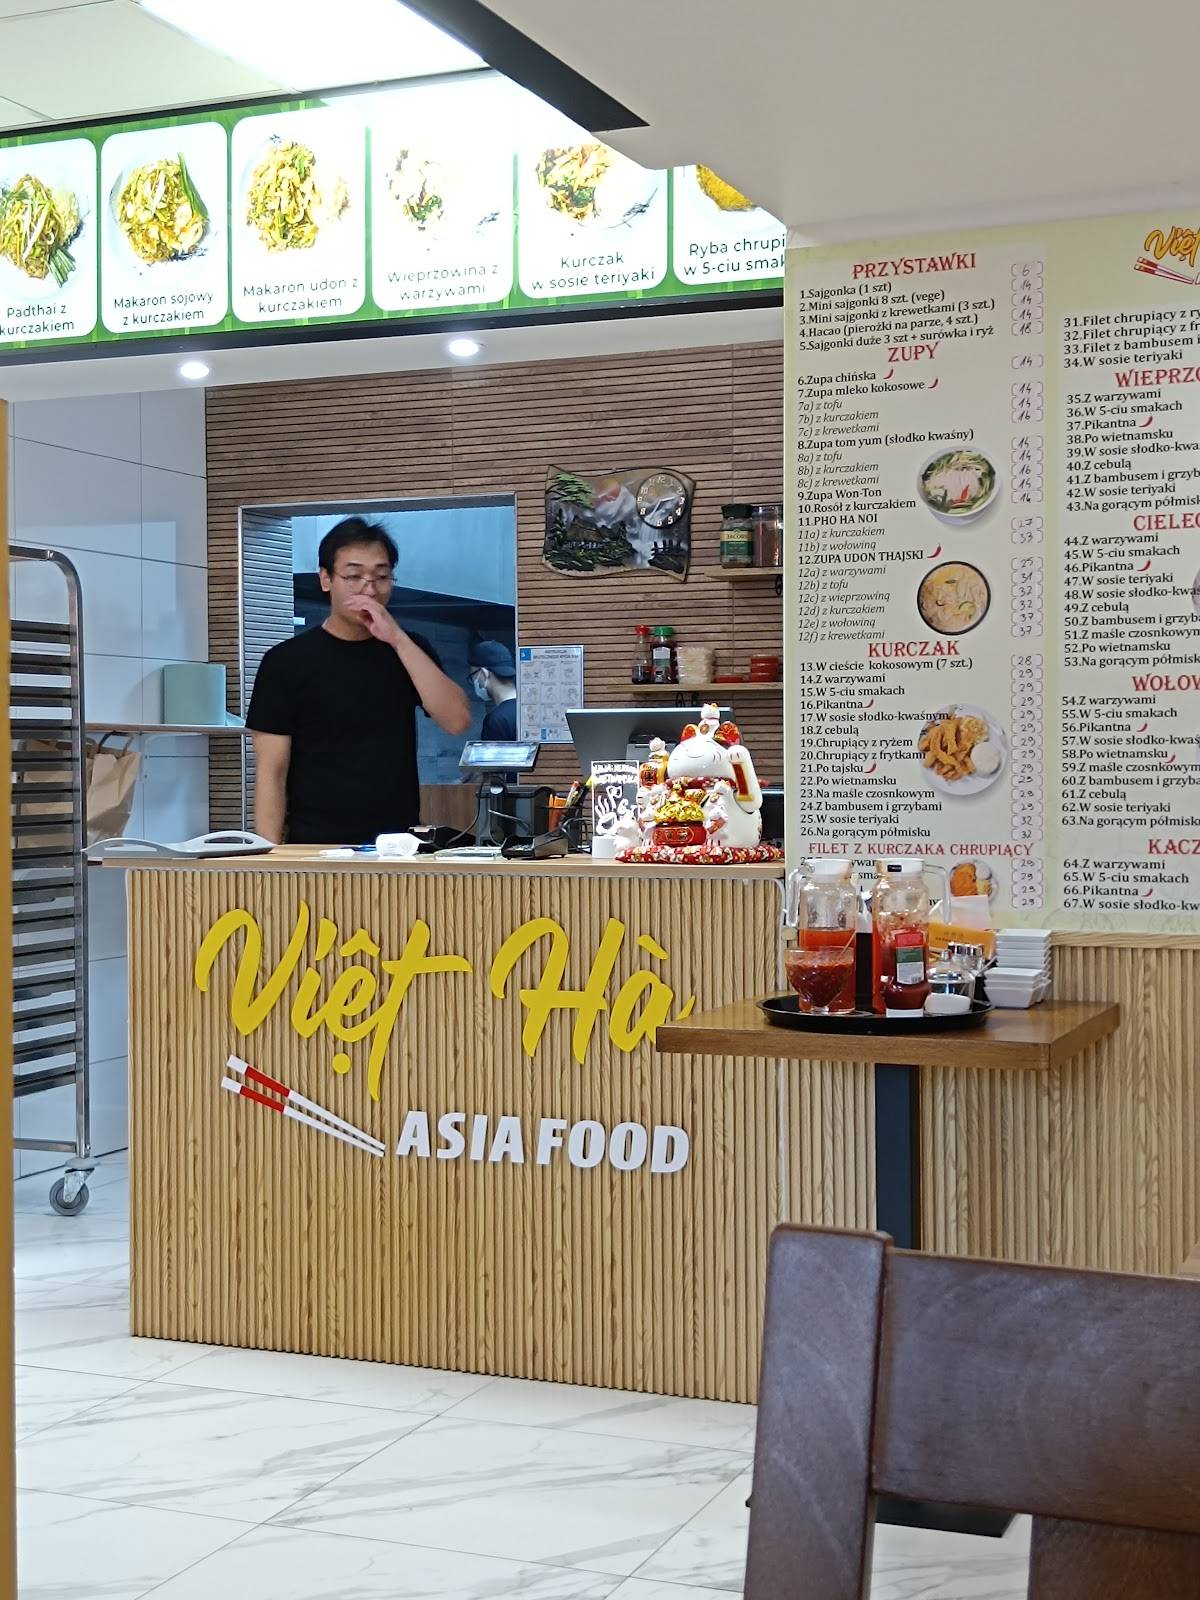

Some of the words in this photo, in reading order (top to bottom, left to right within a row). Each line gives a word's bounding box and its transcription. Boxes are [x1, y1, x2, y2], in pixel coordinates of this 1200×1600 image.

[689, 238, 728, 258] Ryba
[734, 233, 785, 252] chrupi
[561, 251, 624, 268] Kurczak
[684, 265, 697, 275] w
[702, 258, 740, 274] 5-ciu
[853, 253, 976, 279] PRZYSTAWKI
[387, 265, 486, 283] Wieprzowina
[491, 265, 498, 274] z
[531, 280, 543, 290] w
[549, 274, 588, 288] sosie
[594, 266, 655, 286] teriyaki
[243, 281, 305, 296] Makaron
[311, 278, 346, 292] udon
[352, 279, 358, 288] z
[400, 284, 486, 301] warzywami
[800, 286, 856, 300] 1.Sajgonka
[859, 283, 870, 296] (1
[873, 281, 892, 294] szt)
[114, 295, 167, 309] Makaron
[171, 291, 214, 306] sojowy
[259, 297, 342, 312] kurczakiem
[800, 299, 832, 312] 2.Mini
[834, 295, 879, 311] sajgonki
[882, 295, 888, 305] 8
[891, 294, 908, 304] szt.
[912, 290, 945, 304] (vege)
[7, 303, 55, 318] Padthai
[61, 304, 66, 314] z
[123, 316, 129, 325] z
[133, 309, 204, 324] kurczakiem
[800, 313, 832, 325] 3.Mini
[834, 309, 879, 324] sajgonki
[889, 302, 955, 316] krewetkami
[958, 300, 969, 312] (3
[972, 299, 995, 310] szt.)
[800, 325, 841, 338] 4.Hacao
[844, 321, 892, 337] (pierożki
[895, 320, 908, 330] na
[910, 317, 943, 331] parze,
[946, 316, 953, 326] 4
[955, 313, 978, 326] szt.)
[888, 341, 941, 362] ZUPY
[1064, 357, 1096, 368] 34.W
[1099, 353, 1130, 366] sosie
[1134, 349, 1183, 364] teriyaki
[798, 374, 832, 386] 6.Zupa
[835, 370, 876, 383] chińska
[798, 386, 832, 399] 7.Zupa
[836, 384, 868, 396] mleko
[871, 380, 925, 393] kokosowe
[1066, 393, 1091, 404] 35.Z
[1094, 388, 1161, 403] warzywami
[798, 413, 813, 425] 7b)
[815, 414, 821, 422] z
[824, 410, 879, 423] kurczakiem
[1066, 418, 1137, 431] 37.Pikantna
[797, 438, 832, 451] 8.Zupa
[836, 437, 856, 448] tom
[858, 436, 882, 449] yum
[885, 432, 925, 446] (słodko
[928, 428, 974, 443] kwaśny)
[1066, 433, 1098, 444] 38.Po
[1102, 429, 1173, 442] wietnamsku
[657, 475, 665, 483] 12
[797, 490, 832, 503] 9.Zupa
[836, 488, 882, 499] Won-Ton
[675, 507, 682, 516] 4
[798, 501, 843, 514] 10.Rosół
[854, 498, 916, 511] kurczakiem
[667, 516, 673, 524] 5
[798, 515, 837, 527] 11.PHO
[839, 515, 855, 525] HA
[858, 513, 878, 523] NOI
[799, 553, 842, 565] 12.ZUPA
[844, 552, 875, 563] UDON
[878, 550, 924, 562] THAJSKI
[1064, 550, 1094, 559] 45.W
[1097, 549, 1125, 558] 5-ciu
[1128, 545, 1180, 557] smakach
[1064, 562, 1134, 573] 46.Pikantna
[1064, 603, 1089, 612] 49.Z
[1091, 602, 1129, 614] cebulą
[868, 640, 960, 658] KURCZAK
[1064, 643, 1096, 653] 52.Po
[1099, 640, 1171, 652] wietnamsku
[800, 661, 827, 672] 13.W
[829, 661, 864, 671] cieście
[869, 659, 933, 672] kokosowym
[936, 659, 947, 671] (7
[950, 658, 973, 670] szt.)
[800, 675, 822, 685] 14.Z
[824, 673, 885, 684] warzywami
[800, 699, 863, 710] 16.Pikantna
[1062, 696, 1086, 705] 54.Z
[1089, 694, 1156, 707] warzywami
[800, 712, 827, 722] 17.W
[829, 712, 856, 722] sosie
[858, 711, 950, 722] słodko-kwaśnym
[800, 750, 869, 763] 20.Chrupiący
[872, 752, 877, 760] z
[879, 750, 926, 763] frytkami
[1062, 749, 1093, 759] 58.Po
[1096, 748, 1168, 759] wietnamsku
[800, 763, 829, 773] 21.Po
[831, 763, 863, 775] tajsku
[800, 801, 822, 811] 24.Z
[825, 801, 884, 811] bambusem
[891, 801, 942, 814] grzybami
[800, 827, 830, 837] 26.Na
[832, 828, 878, 840] gorącym
[881, 827, 930, 839] półmisku
[808, 842, 848, 854] FILET
[854, 843, 863, 854] Z
[868, 843, 945, 855] KURCZAKA
[950, 842, 1035, 858] CHRUPIĄCY
[1063, 858, 1090, 869] 64.Z
[1093, 859, 1165, 871] warzywami
[1063, 885, 1139, 895] 66.Pikantna
[195, 901, 473, 1101] Việt
[490, 917, 696, 1065] Hà
[396, 1110, 525, 1163] ASIA
[536, 1117, 690, 1174] FOOD
